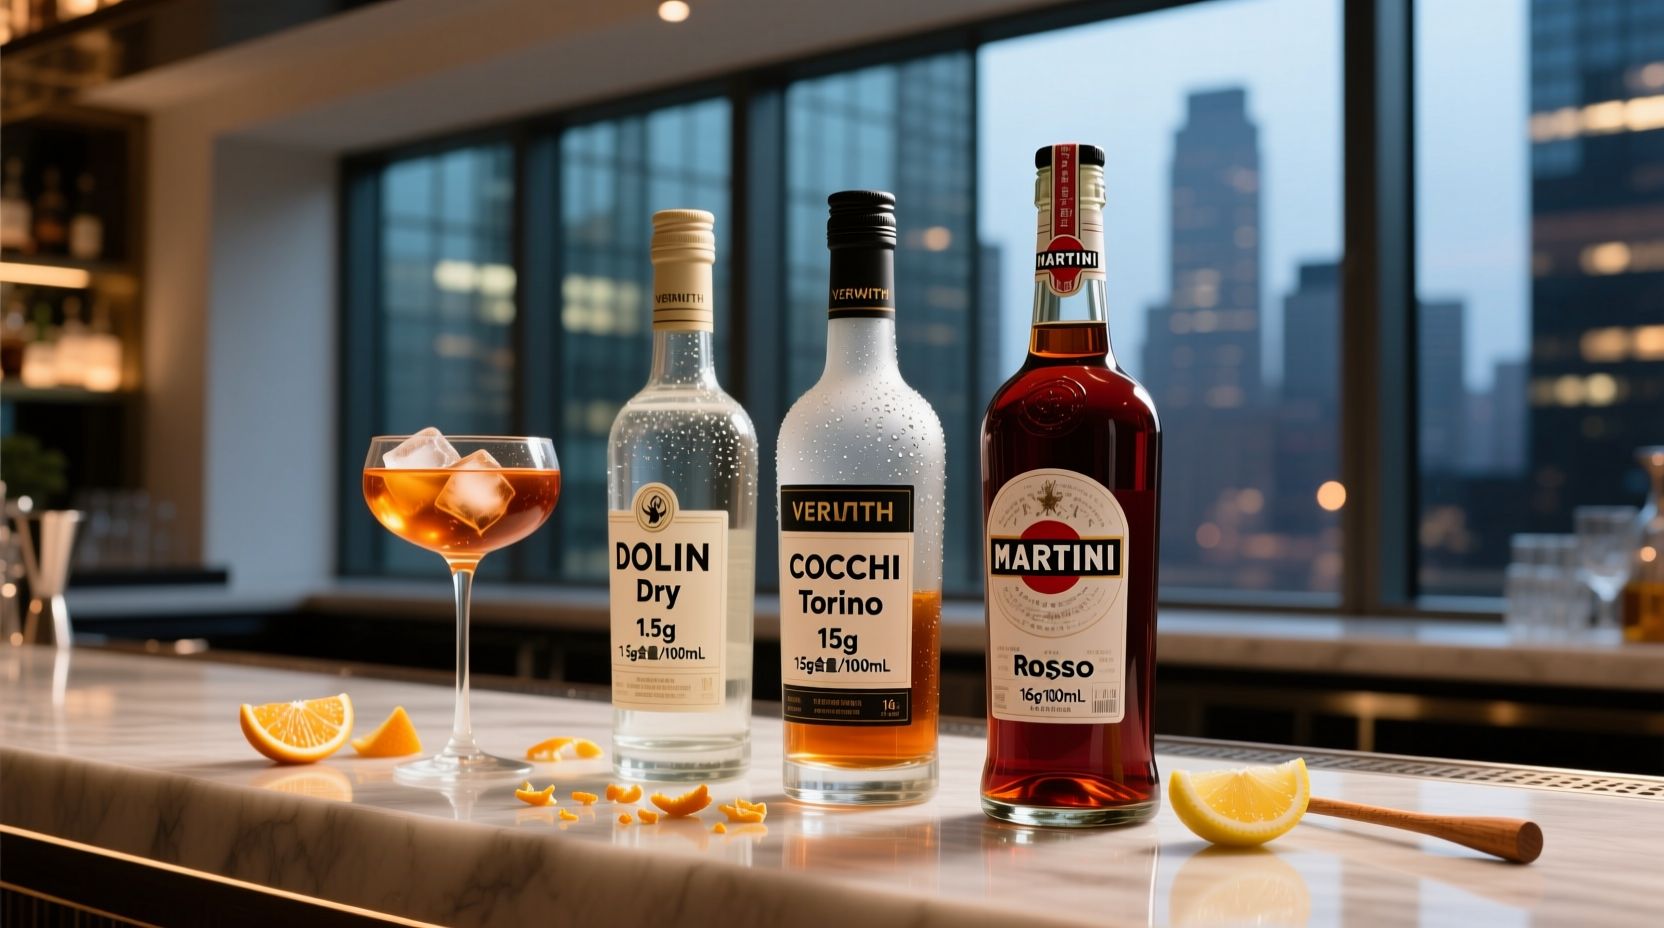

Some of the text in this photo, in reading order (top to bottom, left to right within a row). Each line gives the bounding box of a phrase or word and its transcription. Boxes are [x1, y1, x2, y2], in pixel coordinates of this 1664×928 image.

[616, 541, 709, 572] DOLIN
[790, 553, 899, 580] COCCHI
[995, 543, 1114, 571] MARTINI
[637, 579, 681, 609] Dry
[798, 589, 883, 615] Torino
[636, 618, 676, 644] 1.5g
[818, 627, 858, 655] 15g
[1014, 654, 1094, 680] Rosso
